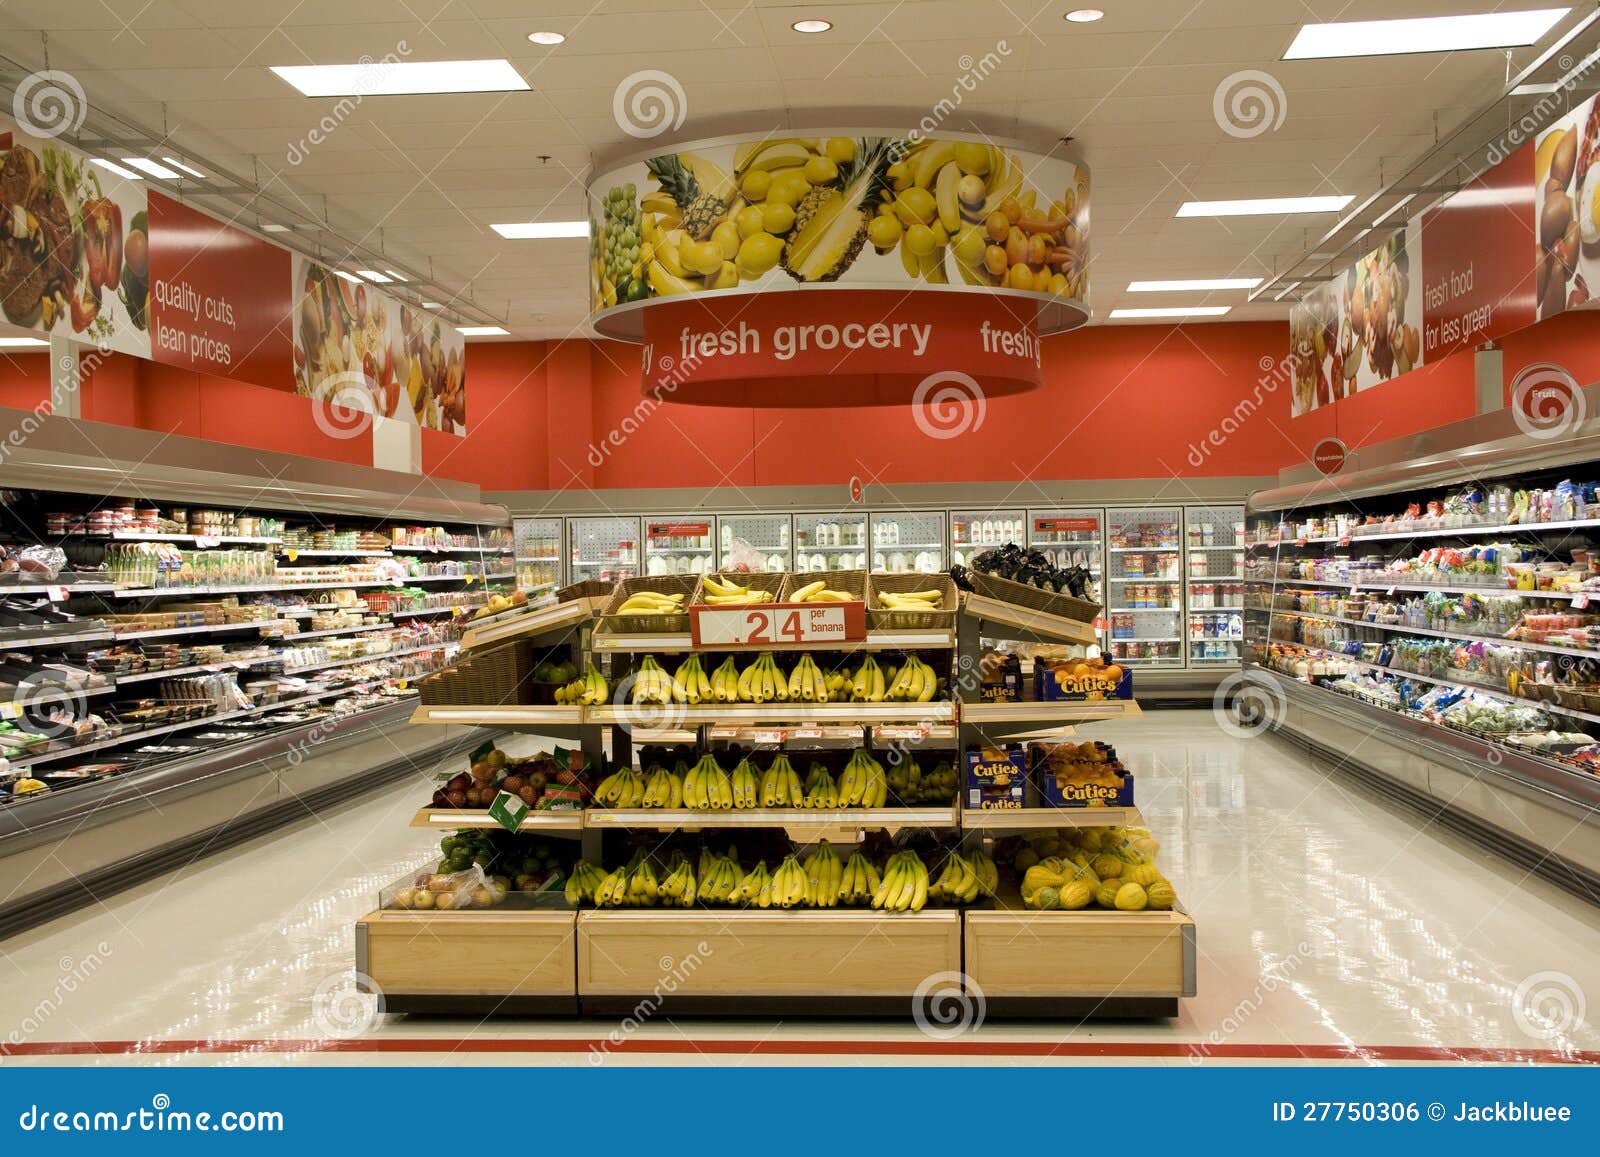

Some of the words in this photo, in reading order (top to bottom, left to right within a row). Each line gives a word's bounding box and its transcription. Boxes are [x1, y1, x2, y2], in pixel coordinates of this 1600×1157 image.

[1425, 276, 1448, 312] fresh
[1451, 261, 1473, 299] food
[155, 280, 201, 322] quality
[205, 297, 236, 331] cuts,
[1426, 324, 1439, 351] for
[1440, 318, 1460, 345] less
[1462, 304, 1491, 343] green
[157, 316, 187, 353] lean
[191, 331, 231, 365] prices
[680, 321, 760, 360] fresh
[773, 322, 932, 361] grocery
[980, 320, 1033, 359] fresh
[1532, 390, 1556, 398] Fruit
[810, 608, 826, 620] per
[811, 621, 844, 632] banana
[1061, 677, 1118, 694] Cuties
[973, 763, 1018, 777] Cuties
[1062, 784, 1118, 800] Cuties
[981, 800, 1022, 809] Cuties
